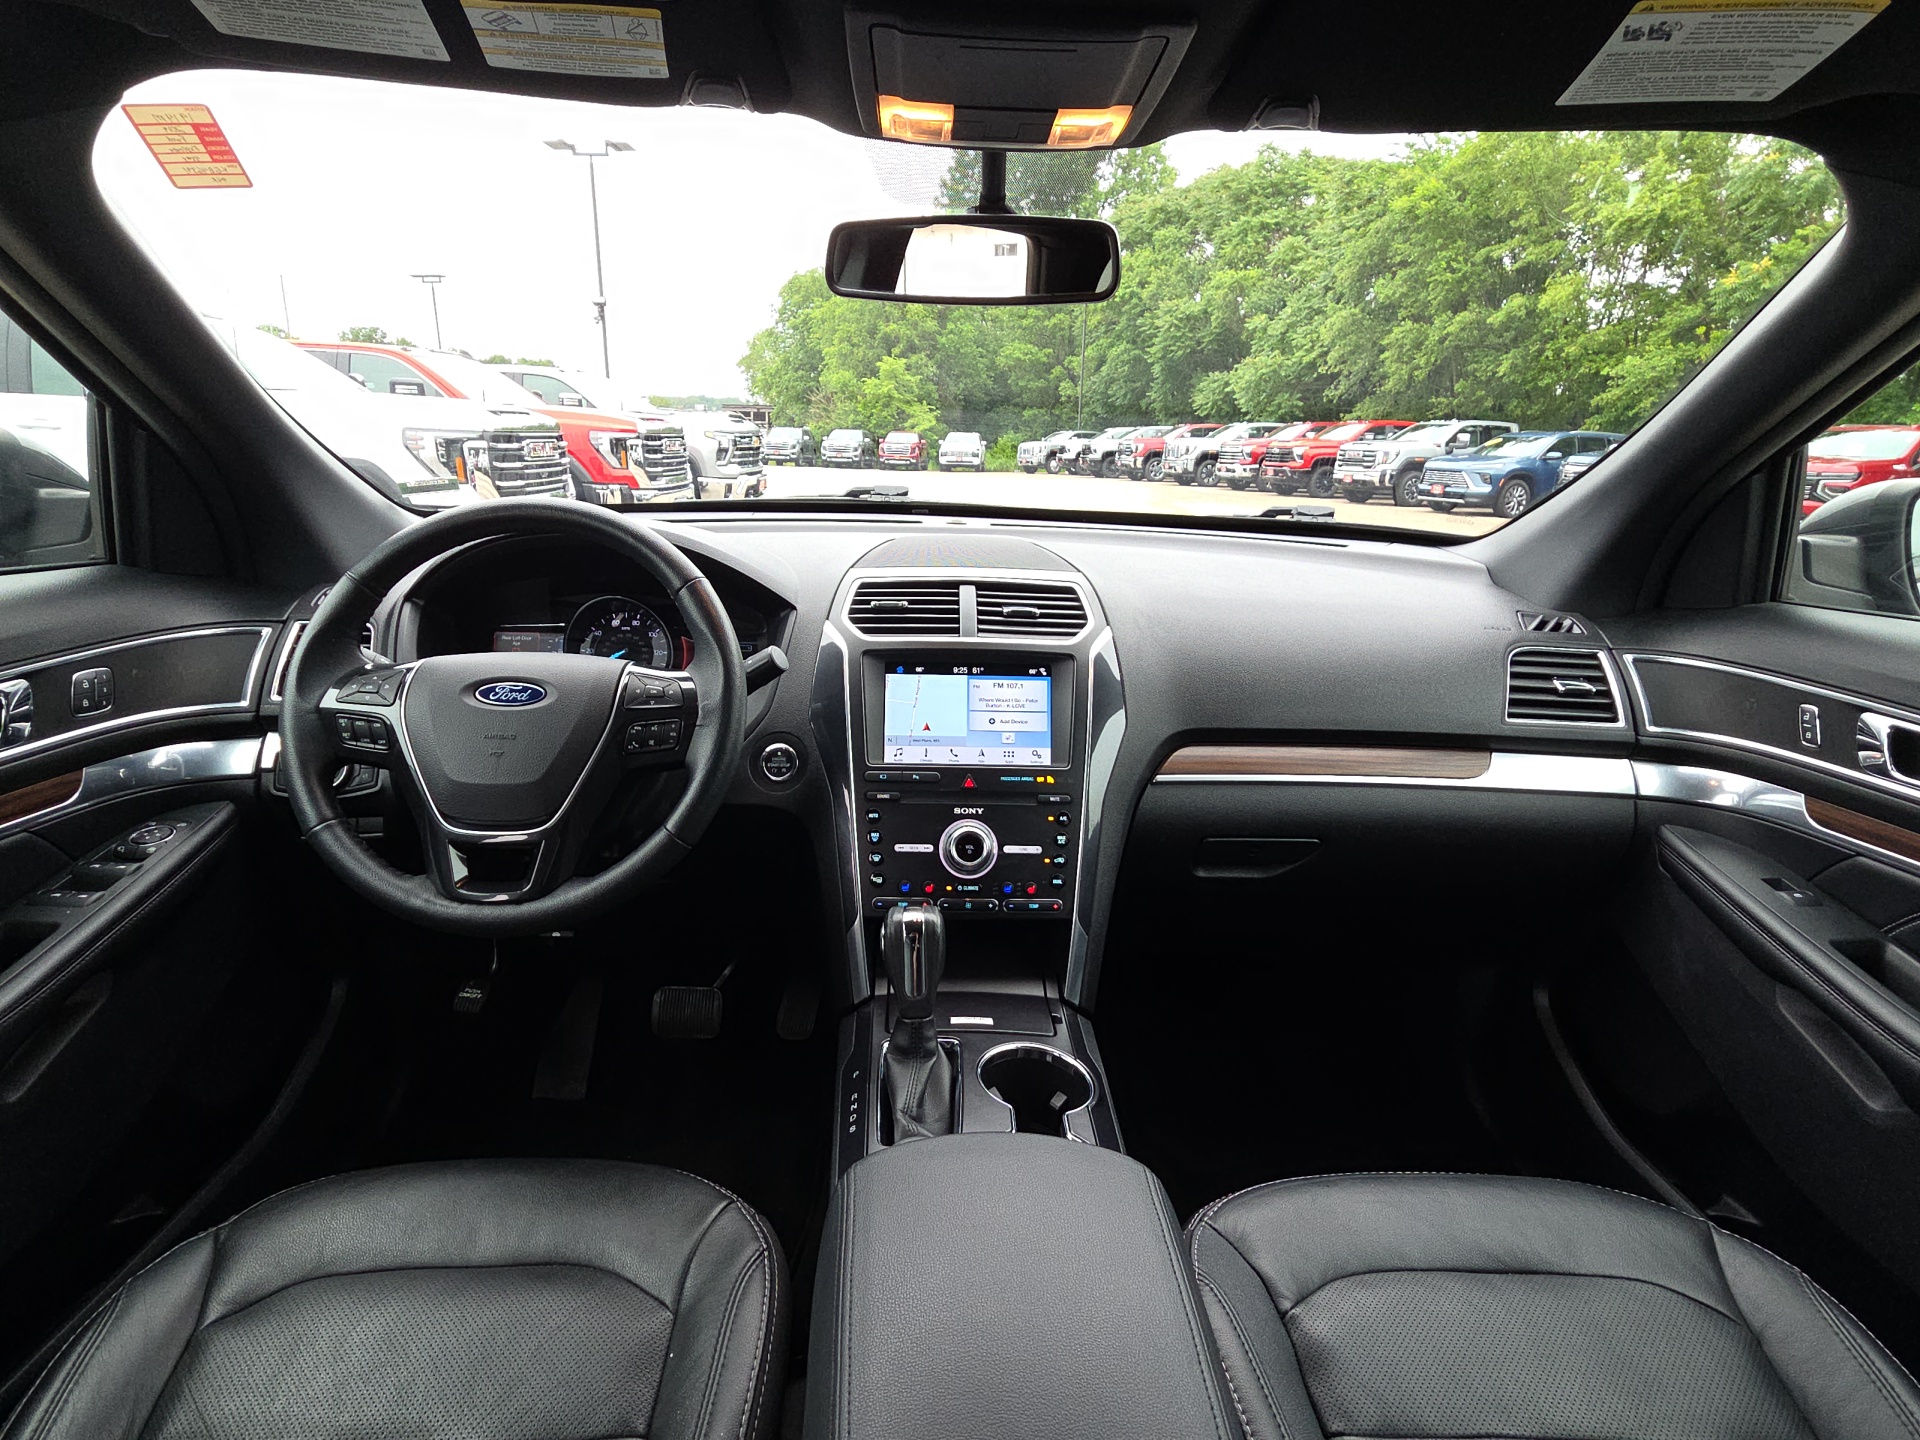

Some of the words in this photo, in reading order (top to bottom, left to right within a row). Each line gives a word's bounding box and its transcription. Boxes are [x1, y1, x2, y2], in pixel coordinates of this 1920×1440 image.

[611, 619, 621, 627] 60
[953, 666, 968, 674] 9:25
[489, 685, 532, 700] Ford
[953, 807, 984, 815] SONY
[850, 1102, 858, 1112] N
[849, 1113, 857, 1123] D
